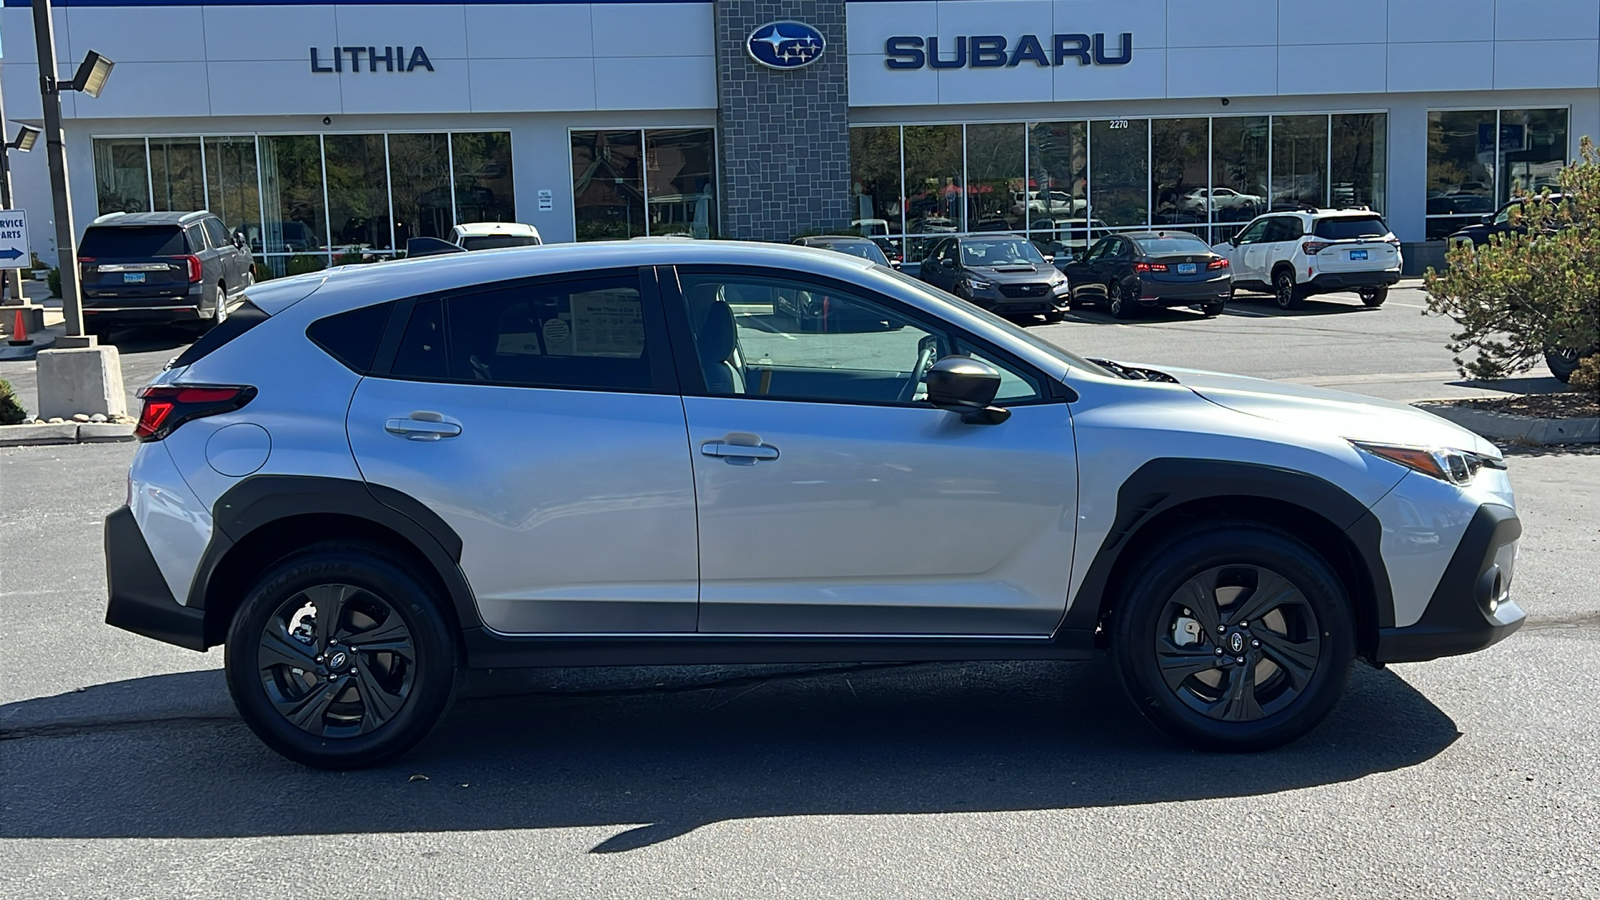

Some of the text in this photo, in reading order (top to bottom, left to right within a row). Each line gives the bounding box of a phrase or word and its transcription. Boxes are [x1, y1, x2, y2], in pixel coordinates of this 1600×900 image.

[885, 33, 1132, 69] SUBARU
[310, 46, 434, 72] LITHIA
[1110, 120, 1128, 129] 2270
[0, 219, 24, 228] RVICE
[0, 230, 21, 239] ARTS
